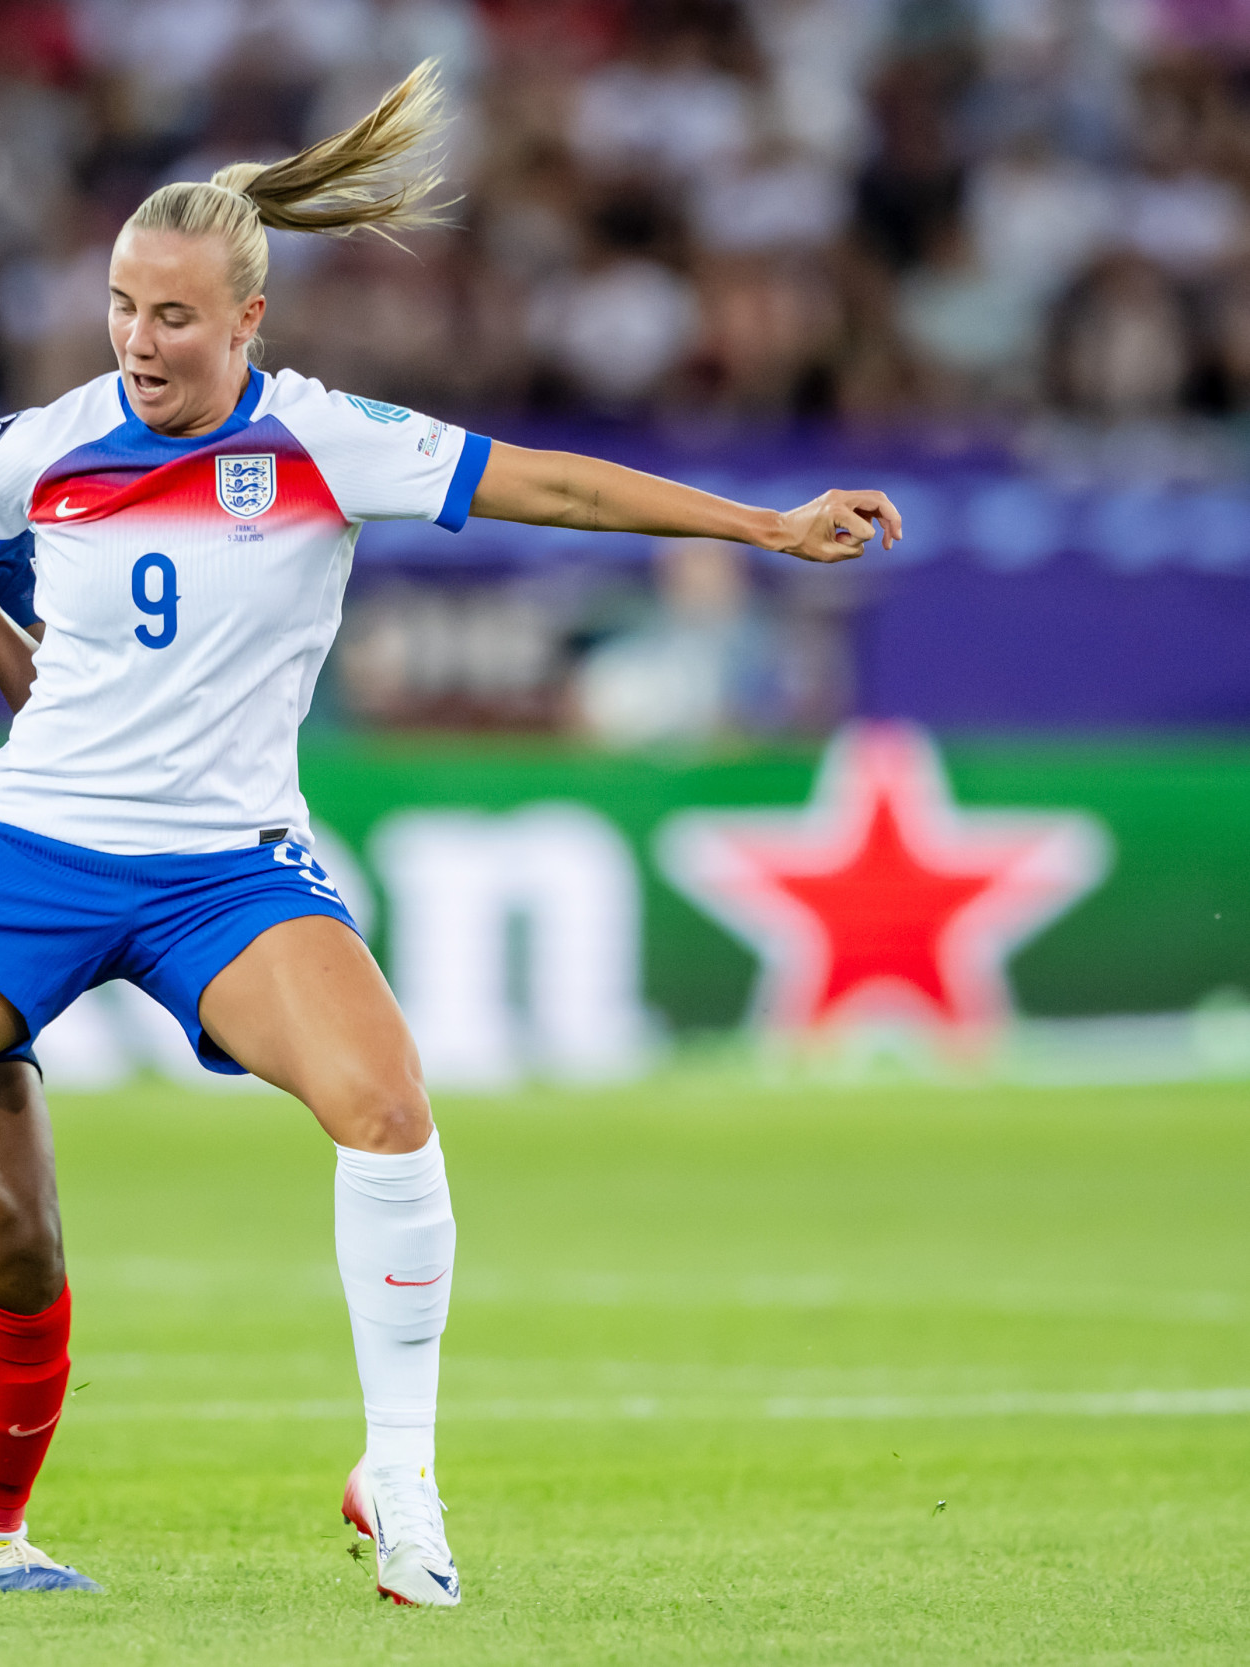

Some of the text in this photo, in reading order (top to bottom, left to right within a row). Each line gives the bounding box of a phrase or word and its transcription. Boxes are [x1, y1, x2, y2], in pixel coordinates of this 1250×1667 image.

[235, 524, 257, 532] FRANCE
[227, 533, 264, 542] 5 JULY 2025
[131, 552, 182, 650] 9
